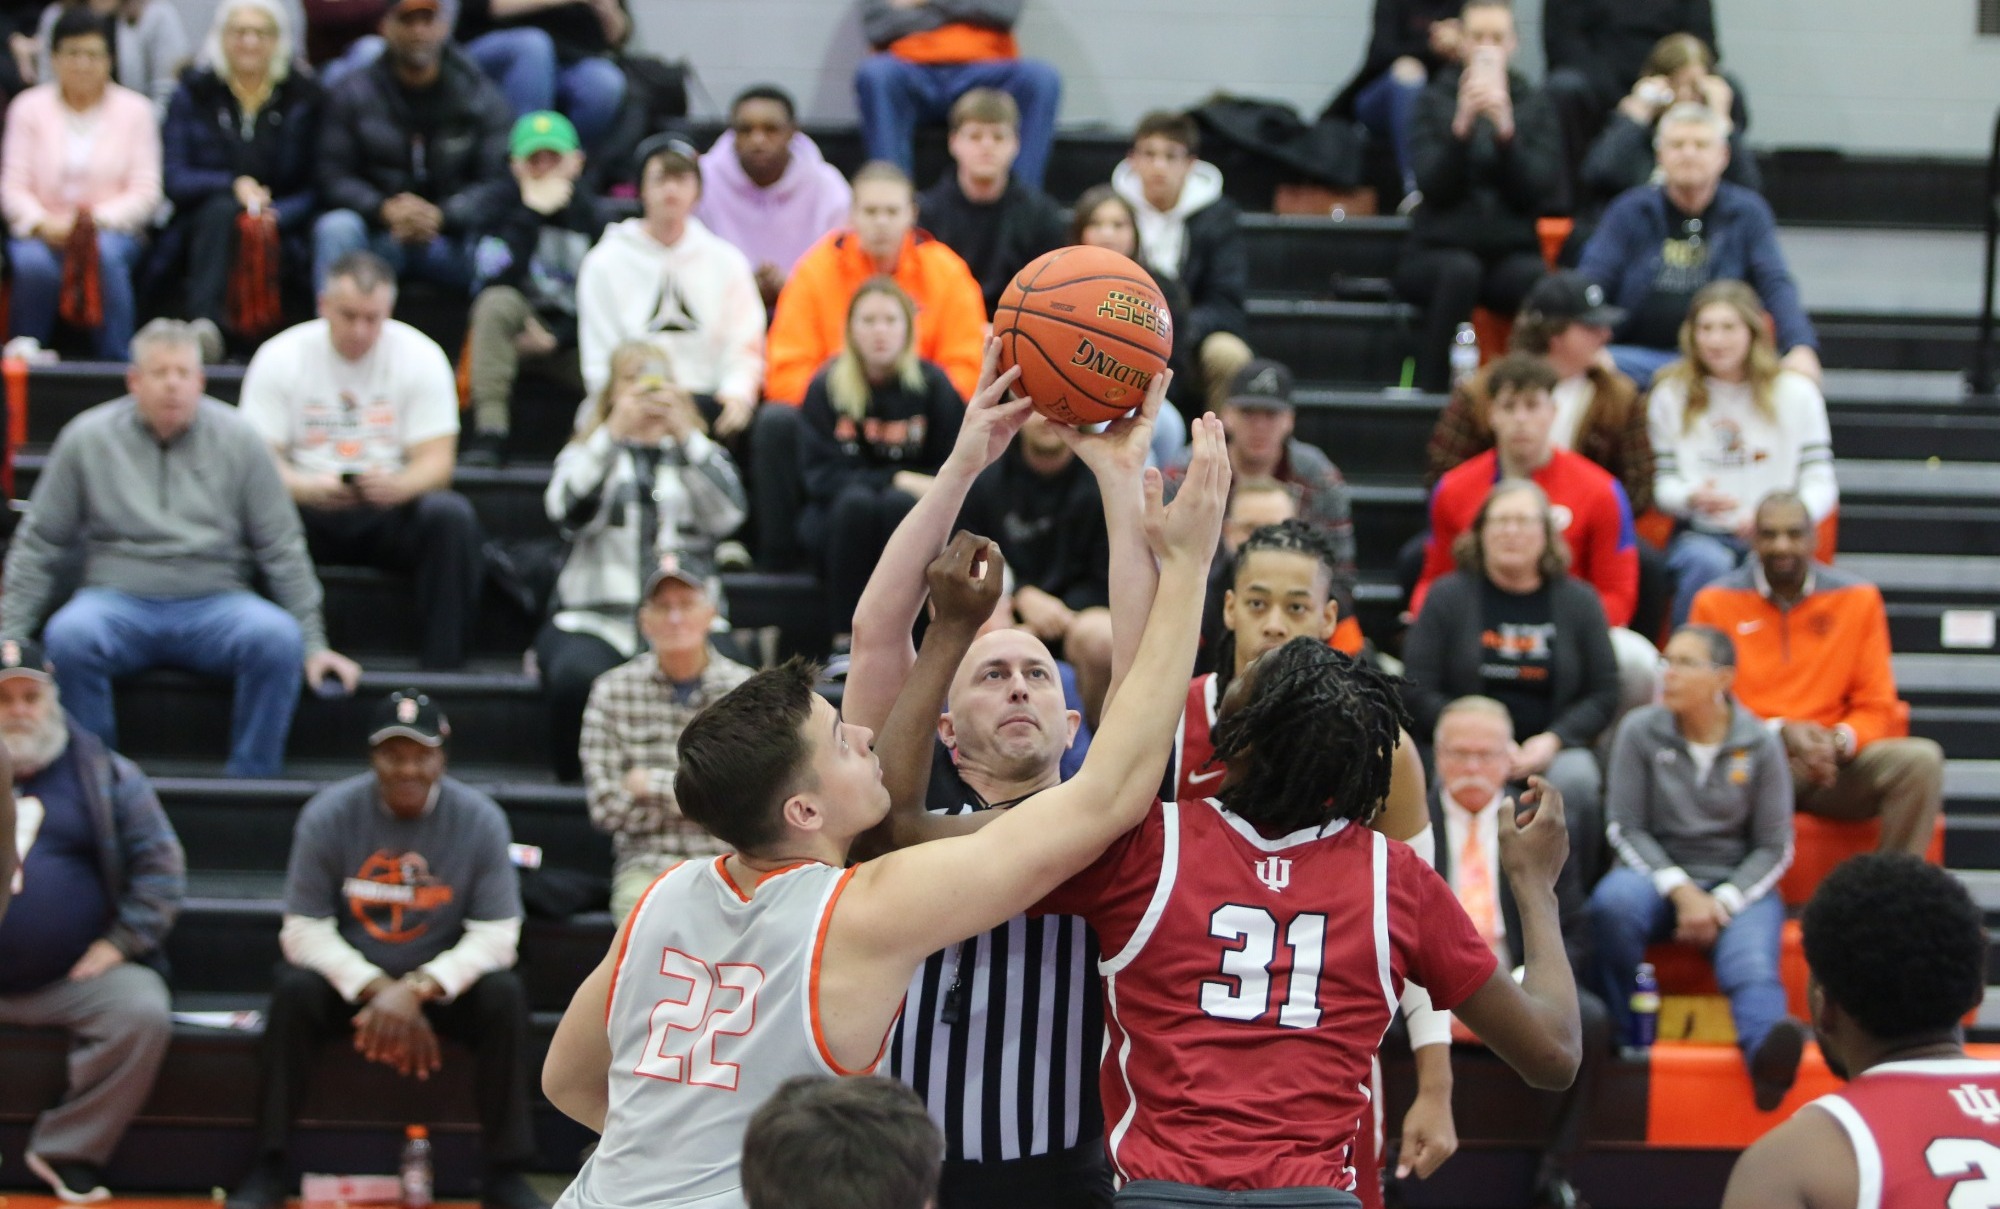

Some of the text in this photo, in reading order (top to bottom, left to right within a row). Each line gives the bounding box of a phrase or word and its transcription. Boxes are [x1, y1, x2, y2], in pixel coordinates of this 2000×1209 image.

[1070, 336, 1151, 394] ALDING
[633, 946, 766, 1092] 22
[1198, 901, 1328, 1029] 31
